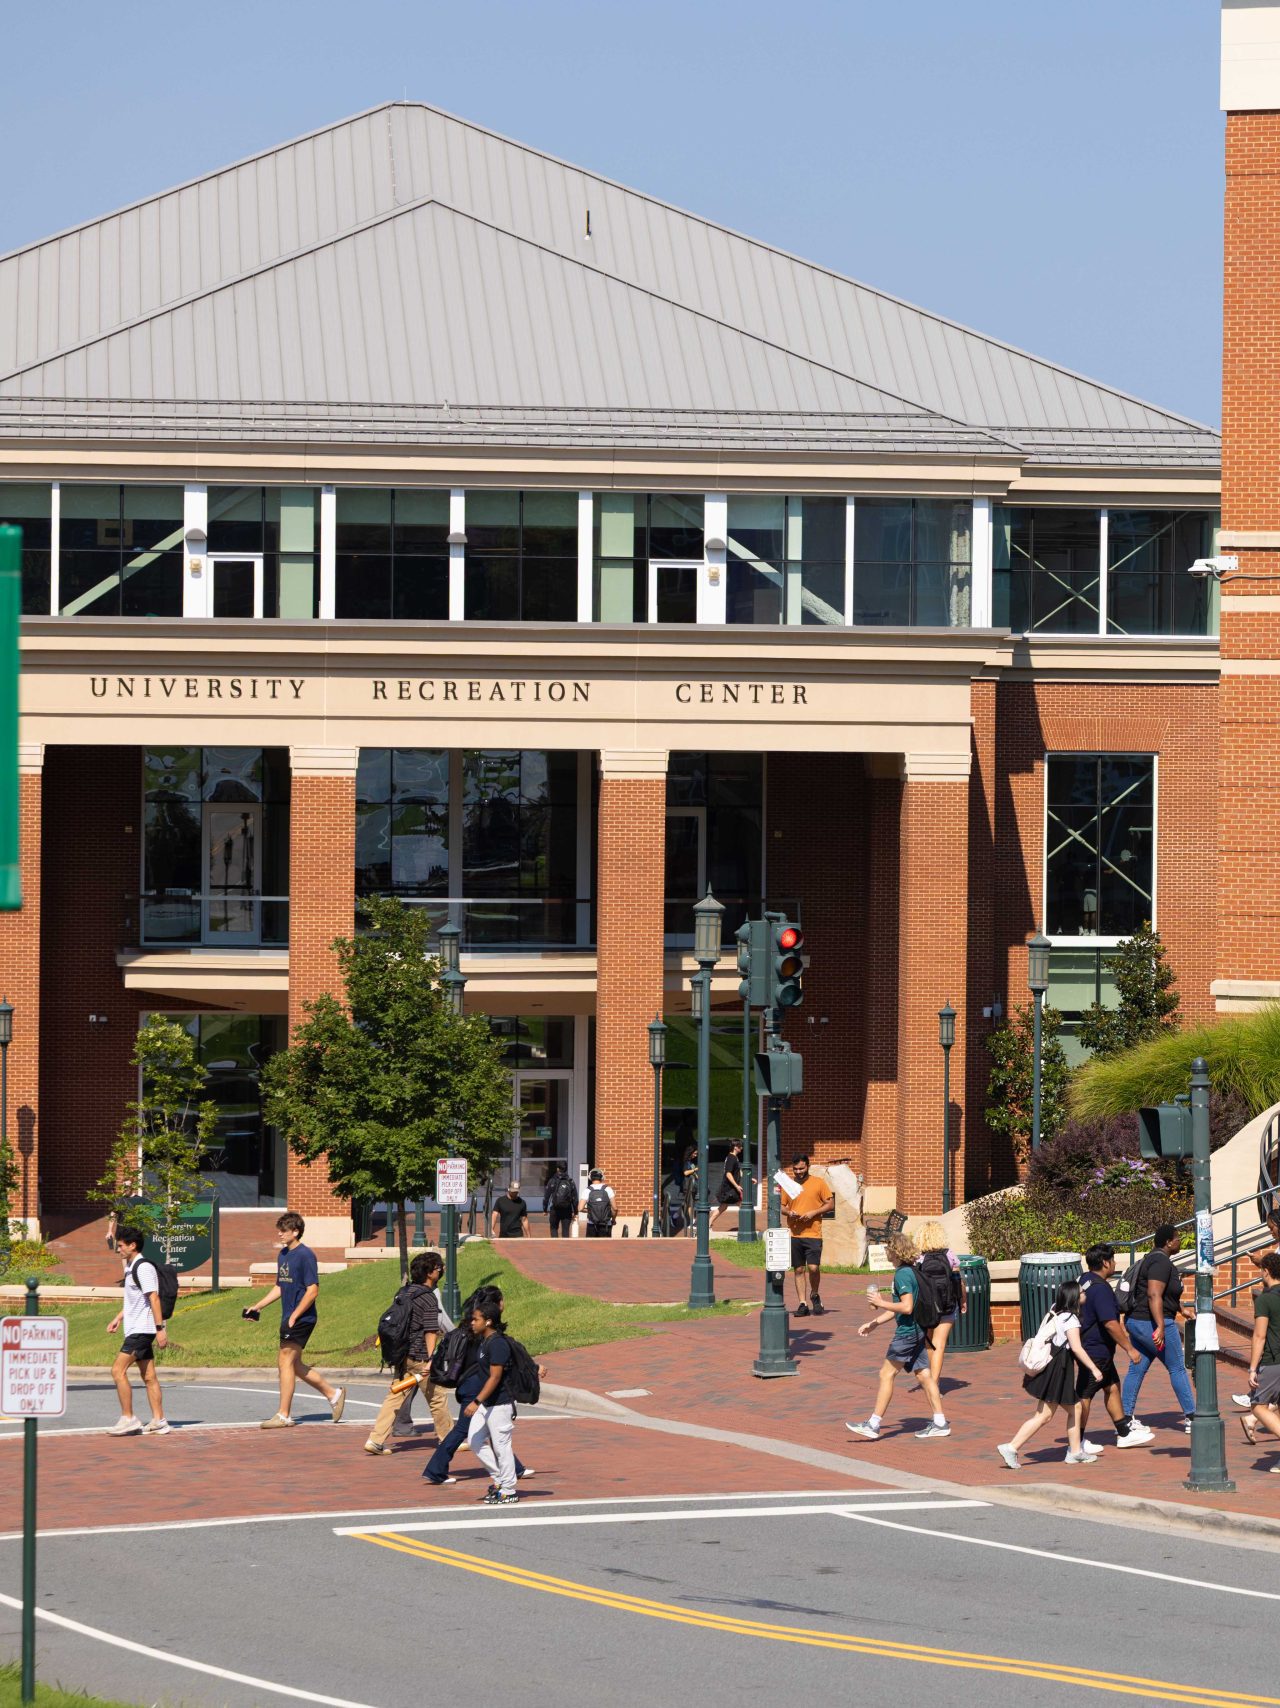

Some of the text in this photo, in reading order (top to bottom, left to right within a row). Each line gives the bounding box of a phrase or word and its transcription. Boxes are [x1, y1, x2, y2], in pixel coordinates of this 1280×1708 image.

[90, 677, 809, 705] UNIVERSITY RECREATION CENTER
[438, 1162, 447, 1171] NO
[152, 1234, 195, 1242] Receation
[159, 1245, 187, 1253] Cnter
[2, 1325, 63, 1344] NO PARKING
[9, 1352, 58, 1364] IMMEDIATE
[9, 1368, 56, 1380] PICK UP &
[10, 1383, 55, 1395] DROP OFF
[20, 1398, 45, 1411] ONLY
